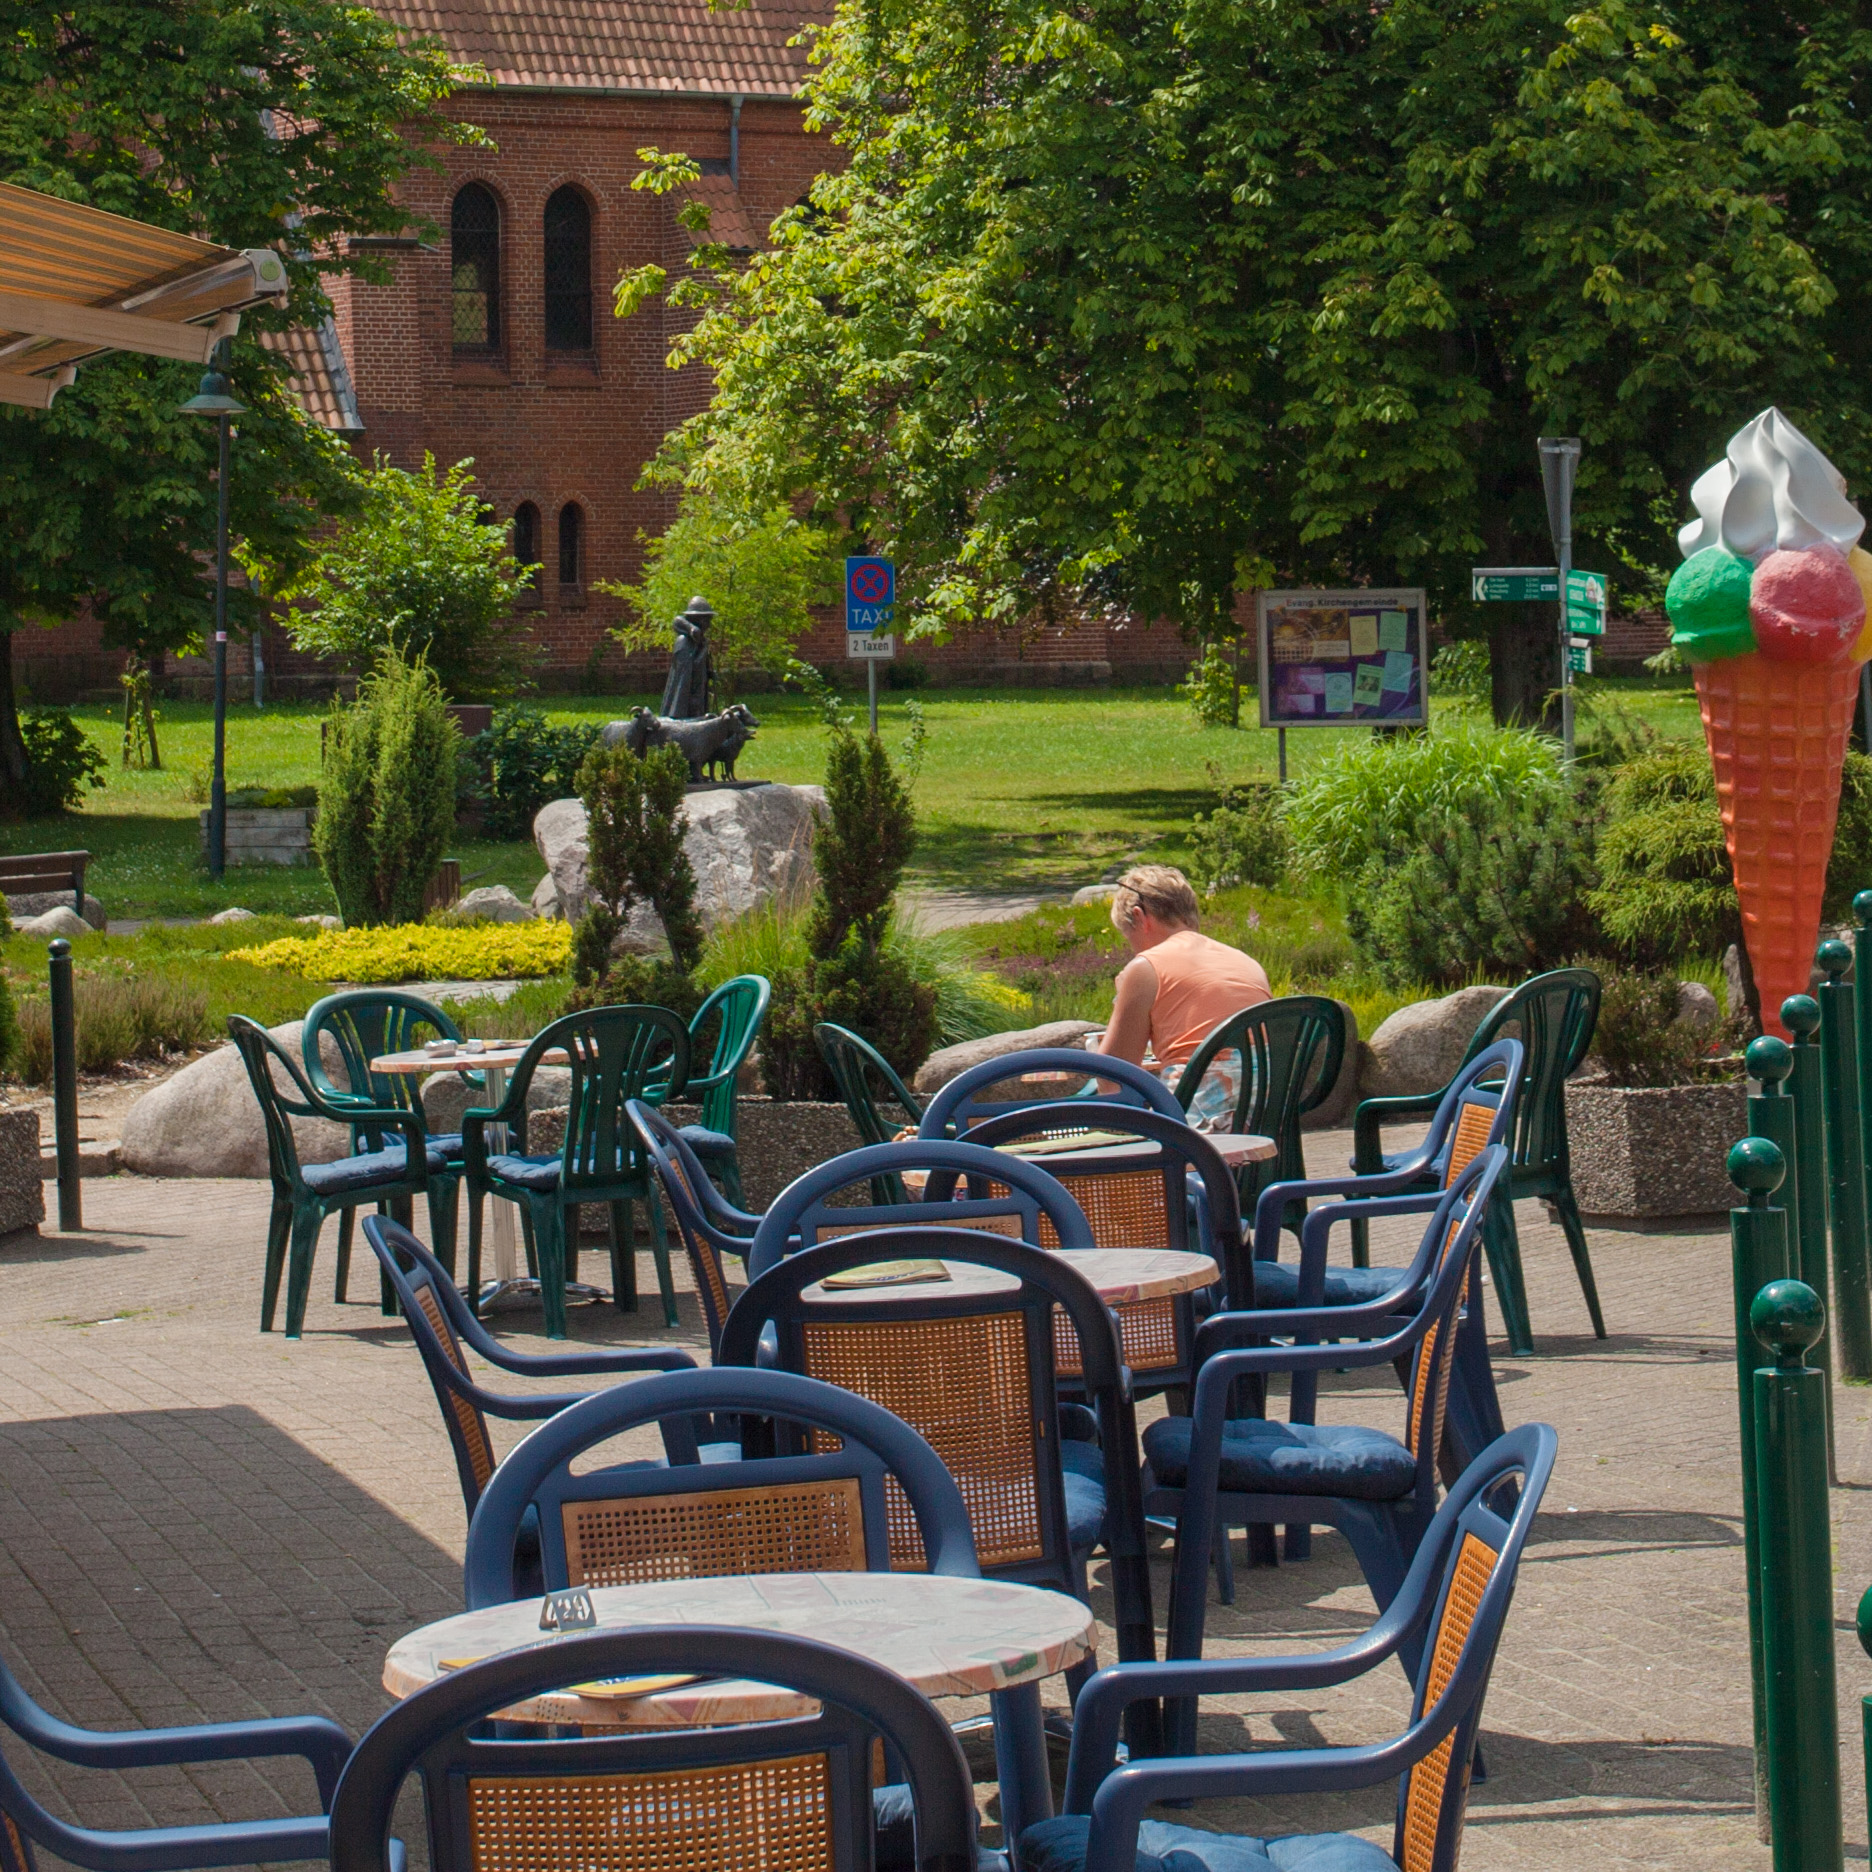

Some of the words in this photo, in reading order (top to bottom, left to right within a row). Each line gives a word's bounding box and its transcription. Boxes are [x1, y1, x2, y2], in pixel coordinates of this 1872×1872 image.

[1318, 598, 1399, 608] Kirchengemeinde
[853, 639, 859, 652] 2
[862, 639, 890, 652] Taxen
[557, 1594, 591, 1622] 29
